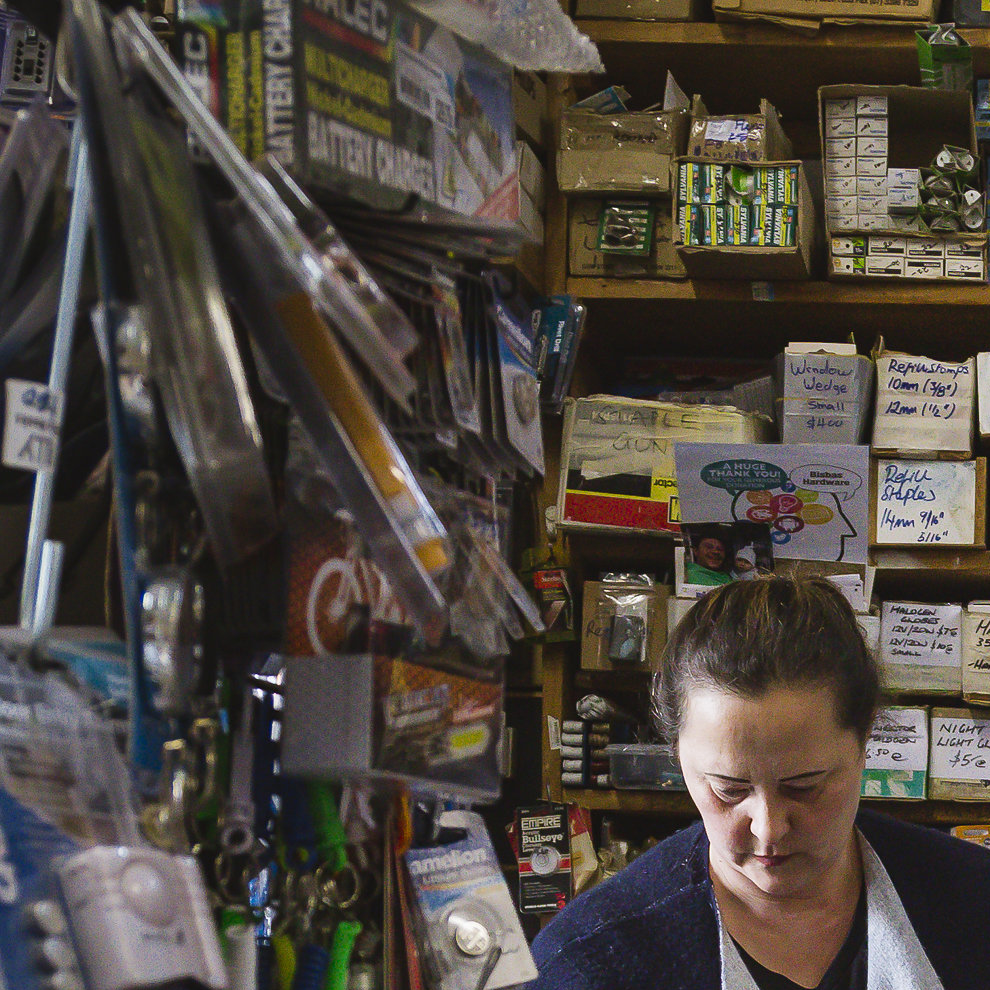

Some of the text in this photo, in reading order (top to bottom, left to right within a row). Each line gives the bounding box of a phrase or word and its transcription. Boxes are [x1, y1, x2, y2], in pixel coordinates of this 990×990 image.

[264, 61, 294, 164] BATTERY
[307, 110, 374, 180] BATTERY
[803, 379, 849, 396] Wedge
[888, 377, 919, 390] 10mm
[807, 400, 845, 412] Small
[885, 401, 918, 414] 12mm
[709, 470, 751, 478] THANK
[885, 465, 933, 485] Refill
[802, 478, 850, 486] Hardware
[881, 485, 936, 506] Staples
[940, 724, 985, 735] NIGHT
[936, 737, 974, 746] LIGHT
[521, 817, 560, 830] EMPIRE
[522, 833, 563, 843] Bullseye
[410, 848, 487, 875] amelion
